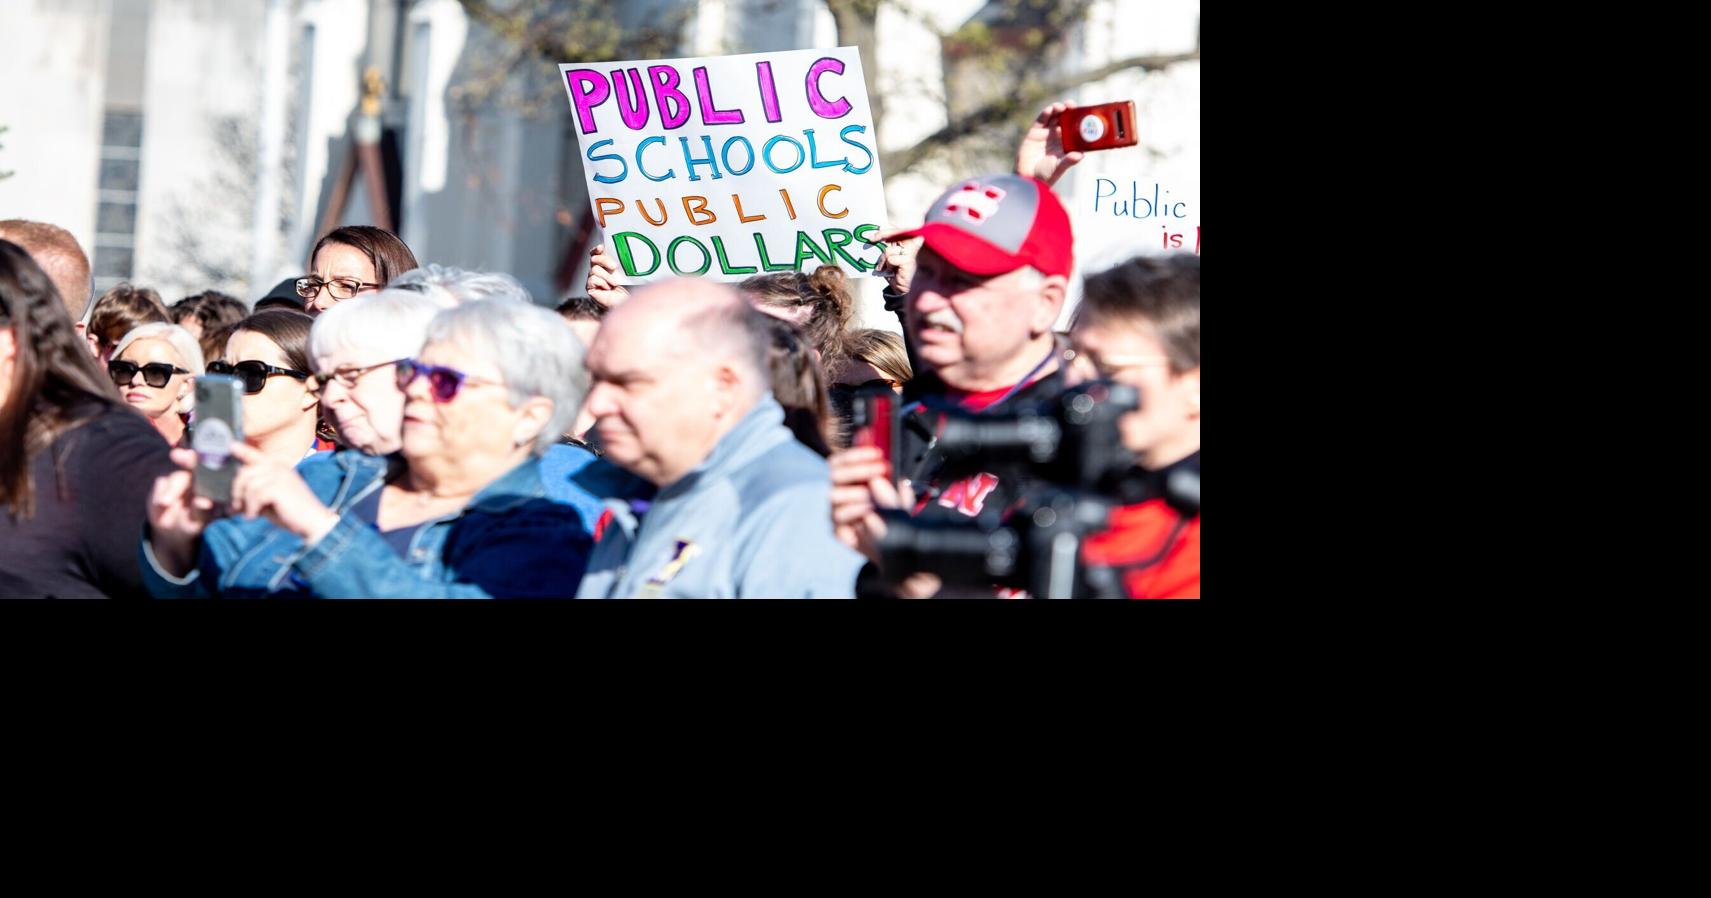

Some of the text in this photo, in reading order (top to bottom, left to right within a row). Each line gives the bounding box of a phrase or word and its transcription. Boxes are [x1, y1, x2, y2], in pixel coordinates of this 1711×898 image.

[565, 57, 853, 135] PUBLIC
[586, 124, 874, 184] SCHOOLS
[594, 184, 849, 228] PUBLIC
[1095, 178, 1187, 219] Public
[612, 223, 888, 277] DOLLARS
[1162, 225, 1183, 249] is
